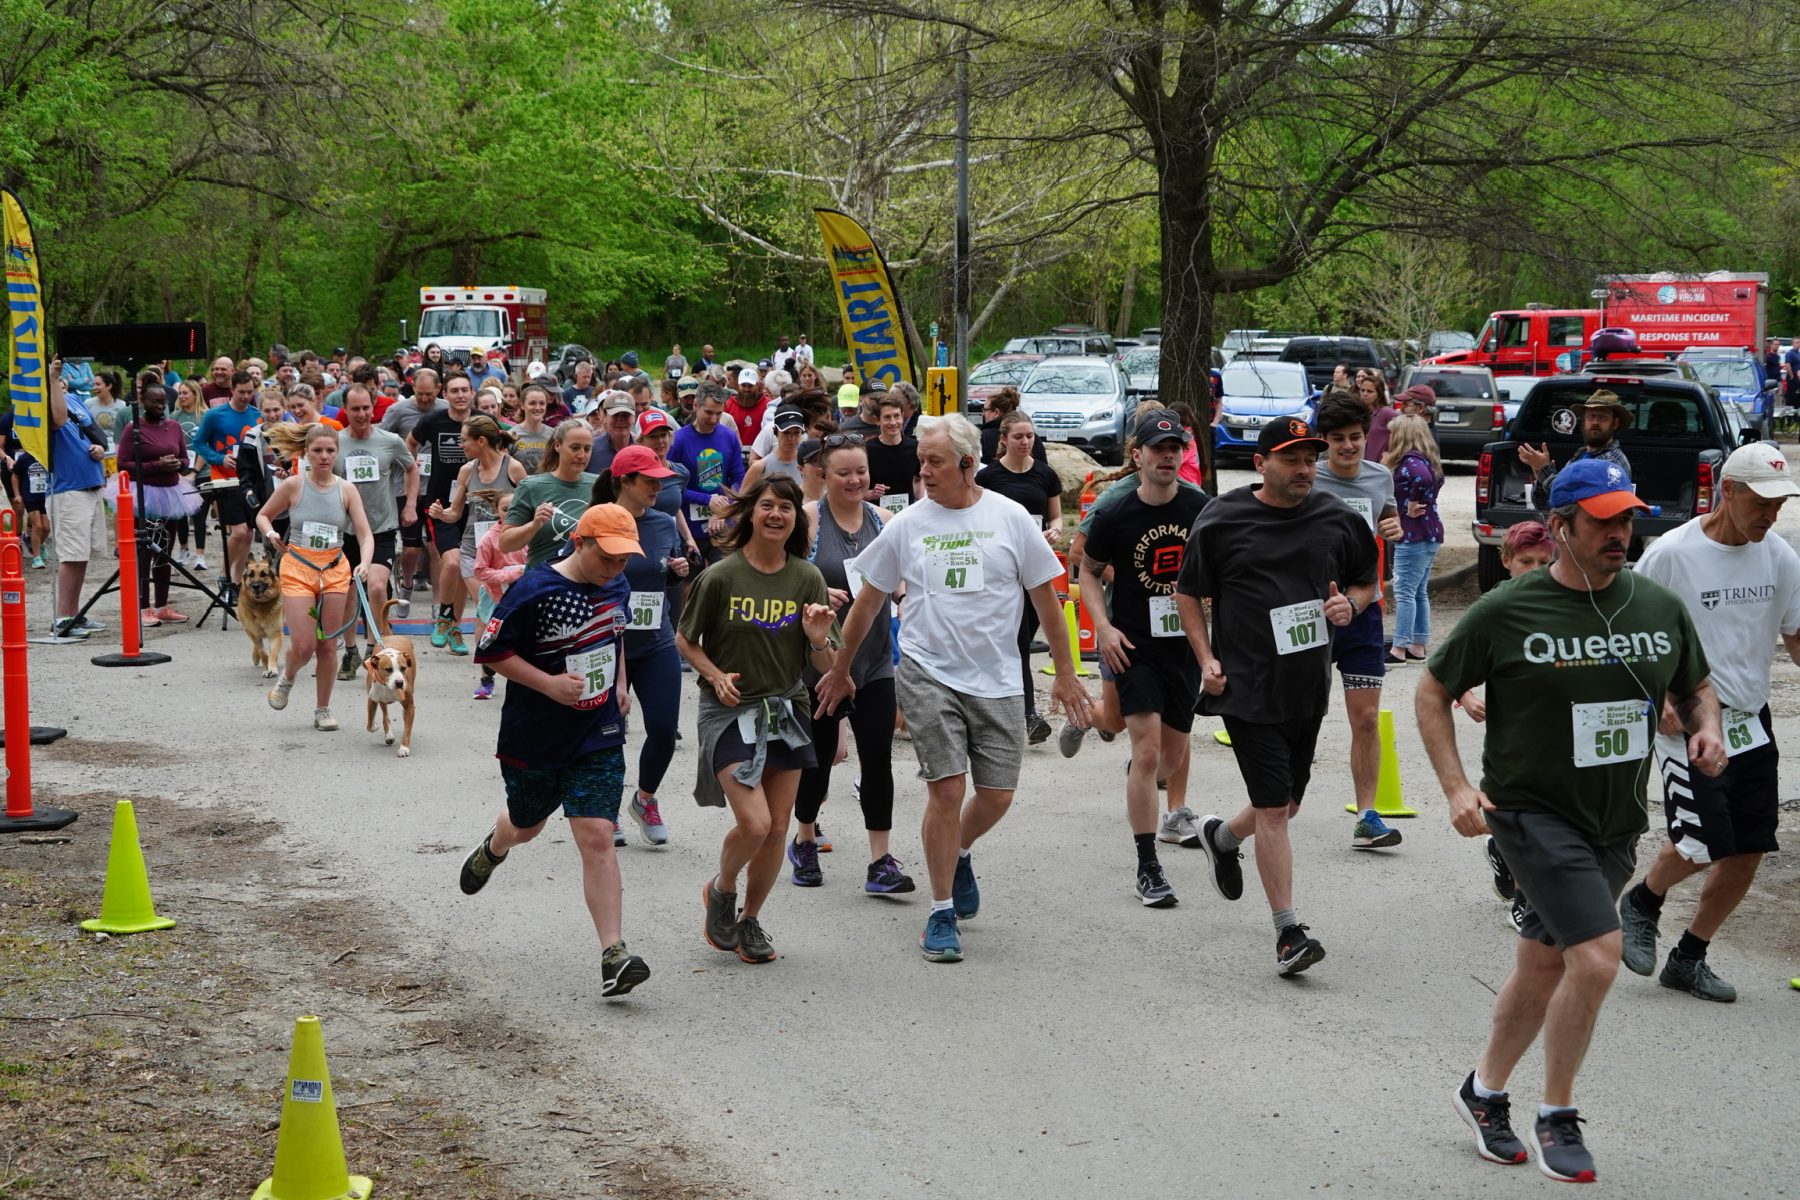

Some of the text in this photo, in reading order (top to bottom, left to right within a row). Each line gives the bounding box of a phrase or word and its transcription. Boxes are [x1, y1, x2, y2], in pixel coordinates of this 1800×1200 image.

[1631, 314, 1730, 322] MARITIME INCIDENT
[841, 280, 902, 383] START
[1640, 333, 1719, 341] RESPONSE TEAM
[352, 467, 373, 479] 134
[1769, 461, 1785, 470] VT
[965, 556, 978, 565] 5k
[945, 568, 966, 589] 47
[633, 608, 653, 626] 30
[1309, 609, 1321, 620] 5k
[1286, 622, 1316, 646] 107
[1523, 631, 1672, 663] Queens
[602, 654, 613, 665] 5k
[586, 668, 605, 693] 75
[1626, 711, 1643, 723] 5k
[1595, 728, 1629, 758] 50
[1728, 723, 1753, 750] 63
